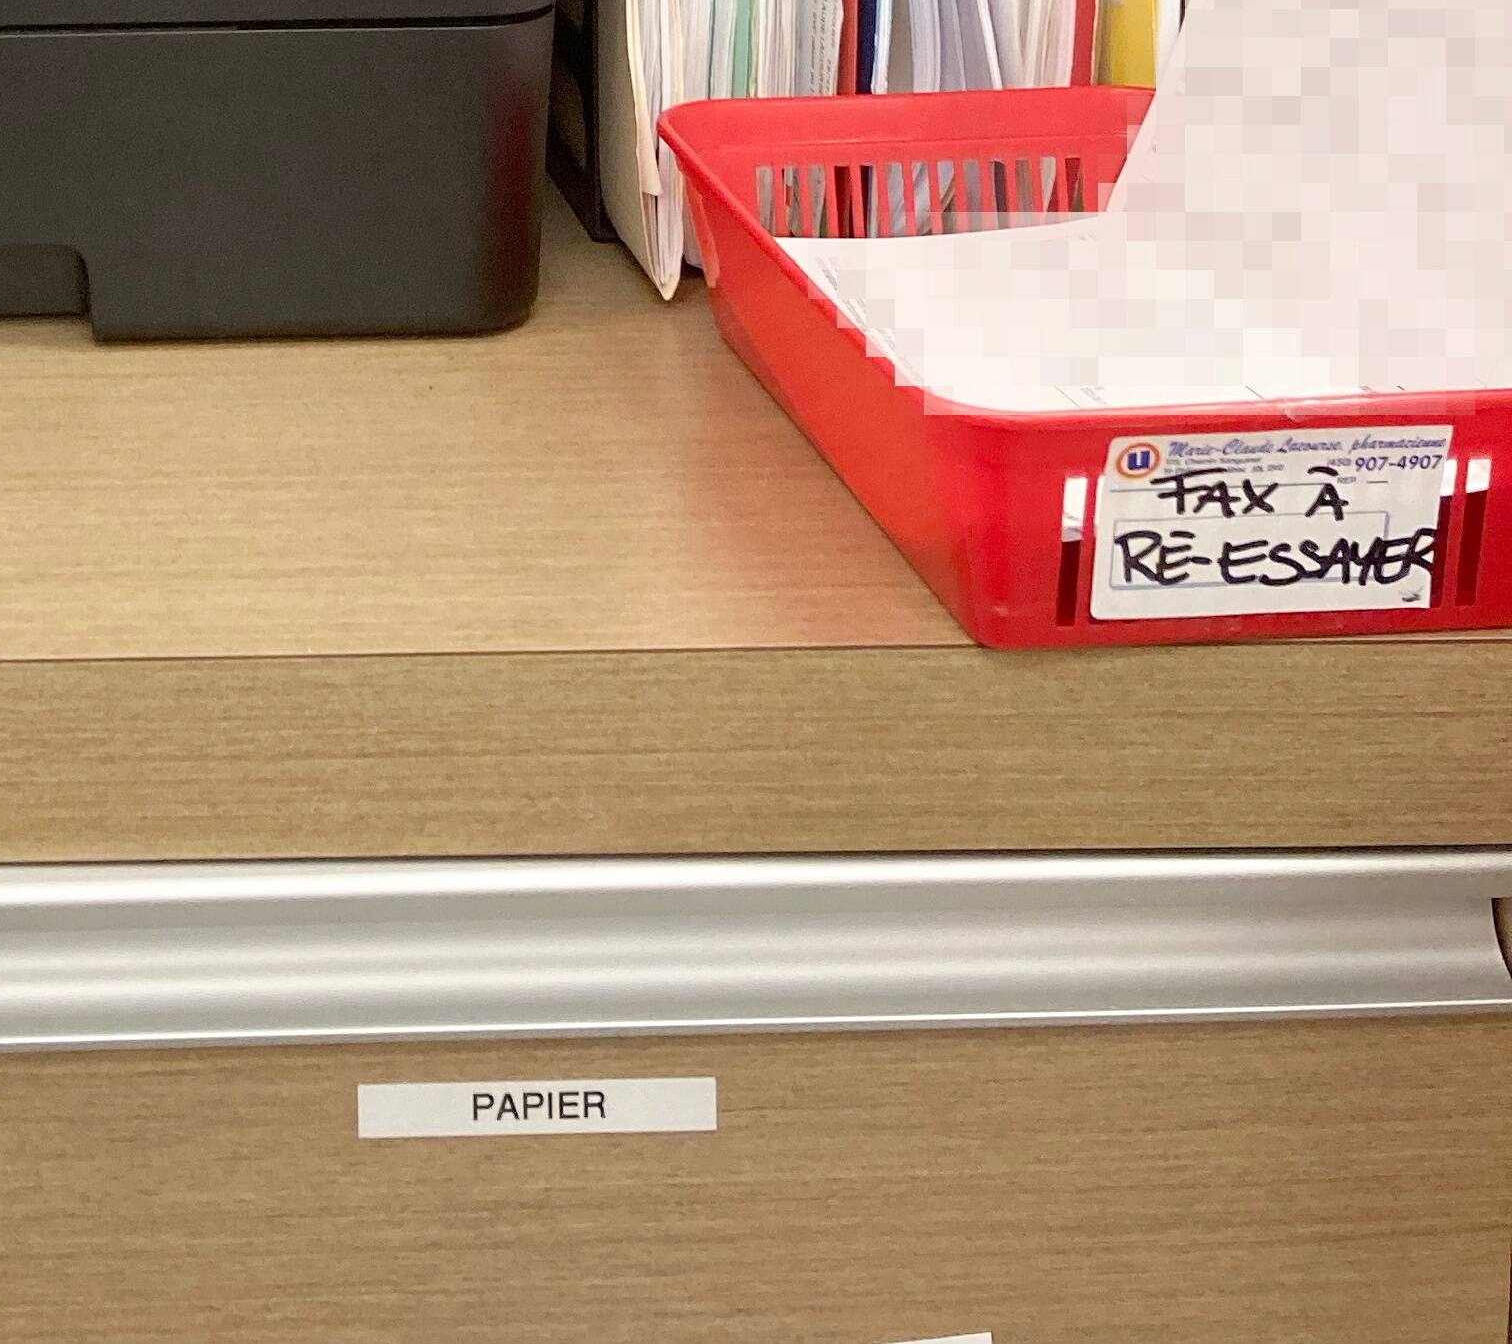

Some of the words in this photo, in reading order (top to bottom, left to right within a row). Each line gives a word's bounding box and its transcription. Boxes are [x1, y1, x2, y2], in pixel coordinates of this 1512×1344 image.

[1354, 454, 1444, 472] 907-4907
[1150, 467, 1279, 519] FAX
[1304, 464, 1350, 522] À
[1113, 527, 1437, 588] RÉ-ESSAYER
[471, 1090, 607, 1122] PAPIER
